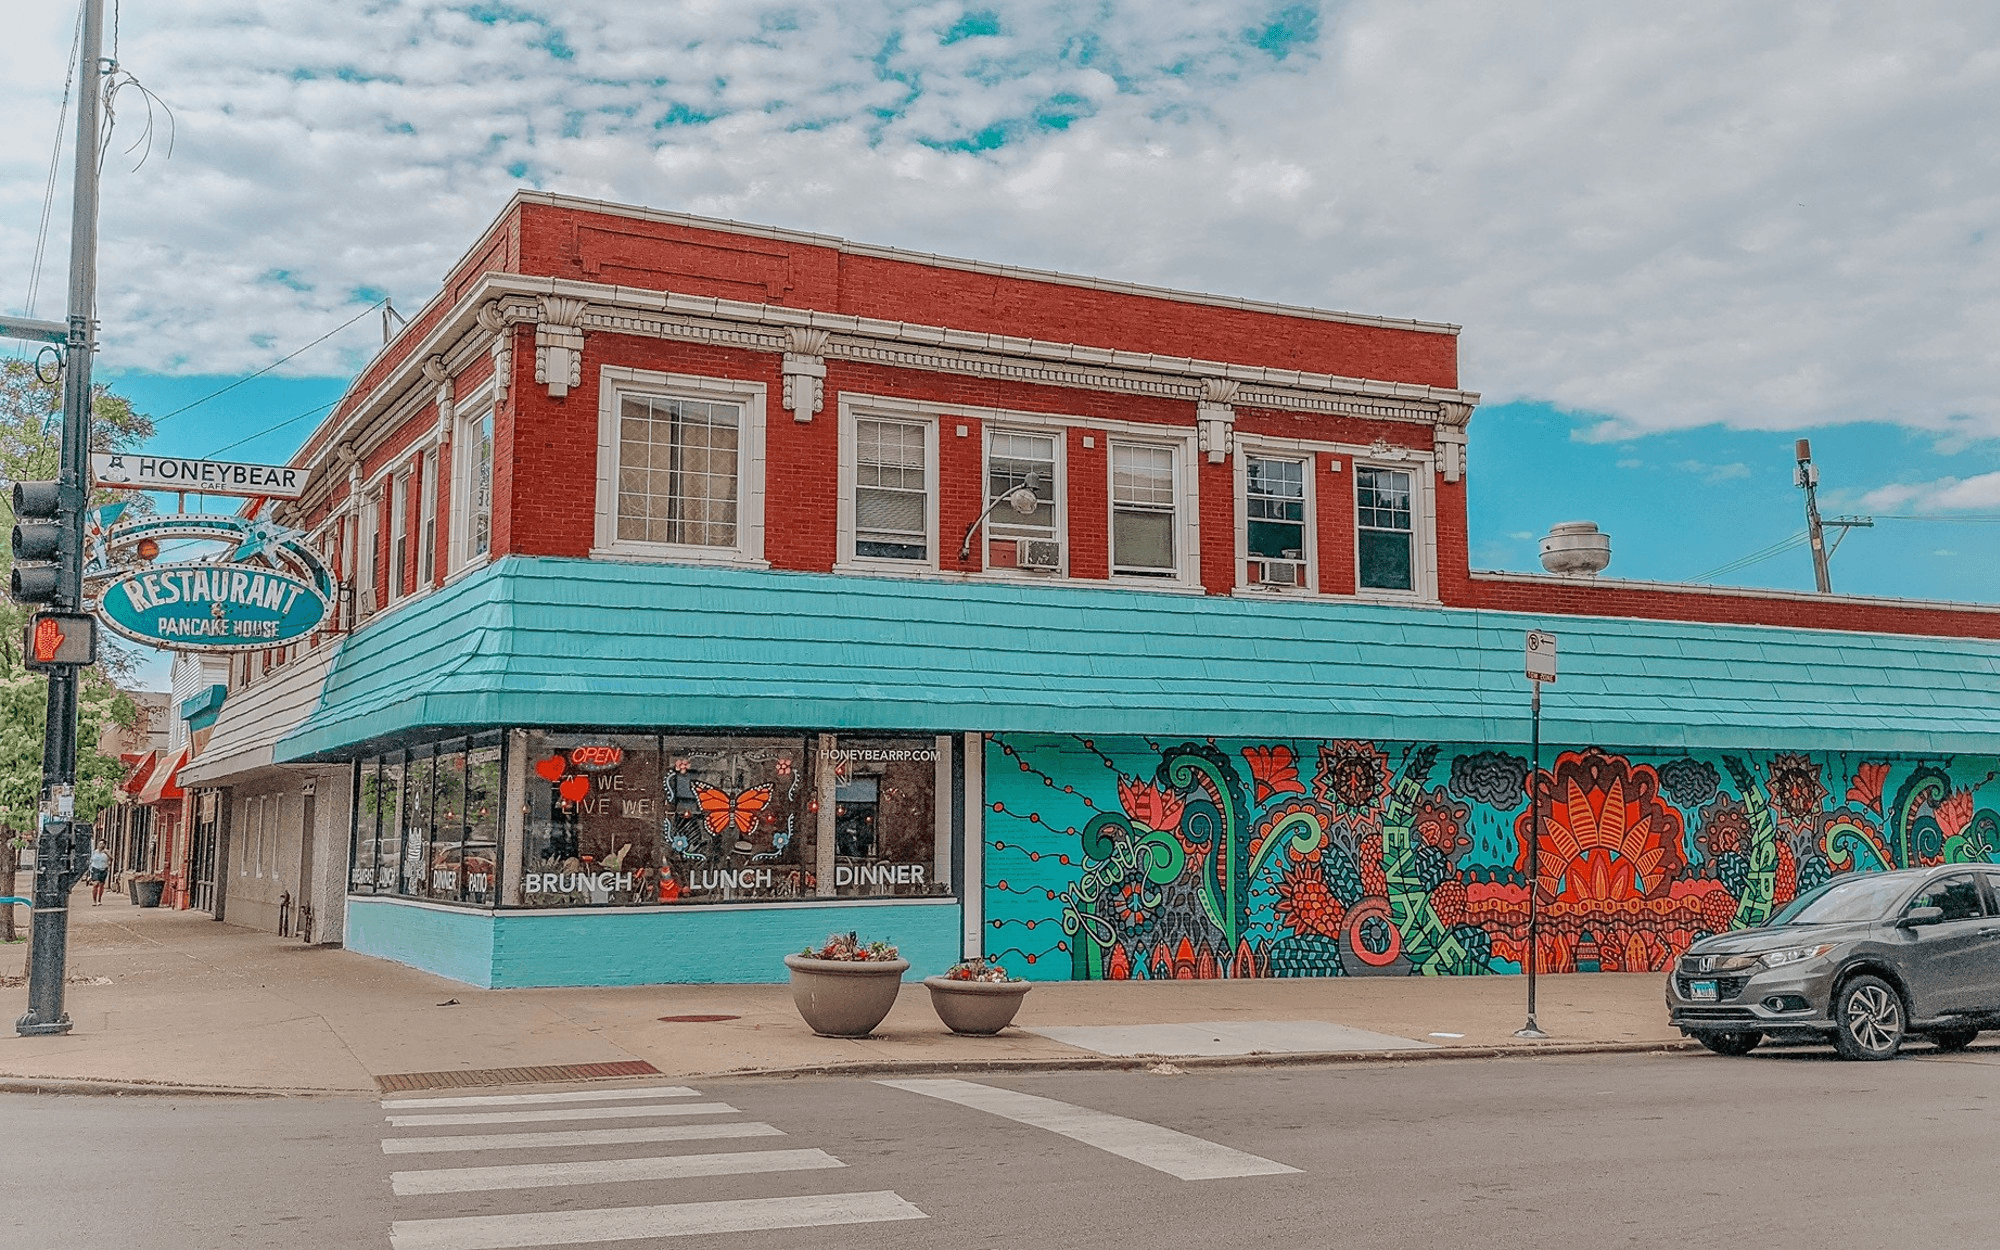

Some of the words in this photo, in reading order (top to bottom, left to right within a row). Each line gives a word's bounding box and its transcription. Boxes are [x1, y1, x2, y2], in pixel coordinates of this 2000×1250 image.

[138, 457, 297, 489] HONEYBEAR
[200, 481, 227, 491] CAFE
[122, 569, 305, 615] RESTAURANT
[157, 616, 229, 636] PANCAKE
[232, 620, 280, 638] HOUSE
[572, 746, 621, 764] OPEN
[820, 749, 941, 762] HONEYBEARRP.COM
[433, 869, 457, 890] DINNER
[468, 872, 487, 893] PATIO
[525, 870, 633, 893] BRUNCH
[689, 869, 772, 890] LUNCH
[836, 865, 925, 886] DINNER
[1383, 775, 1467, 977] ELEVATE
